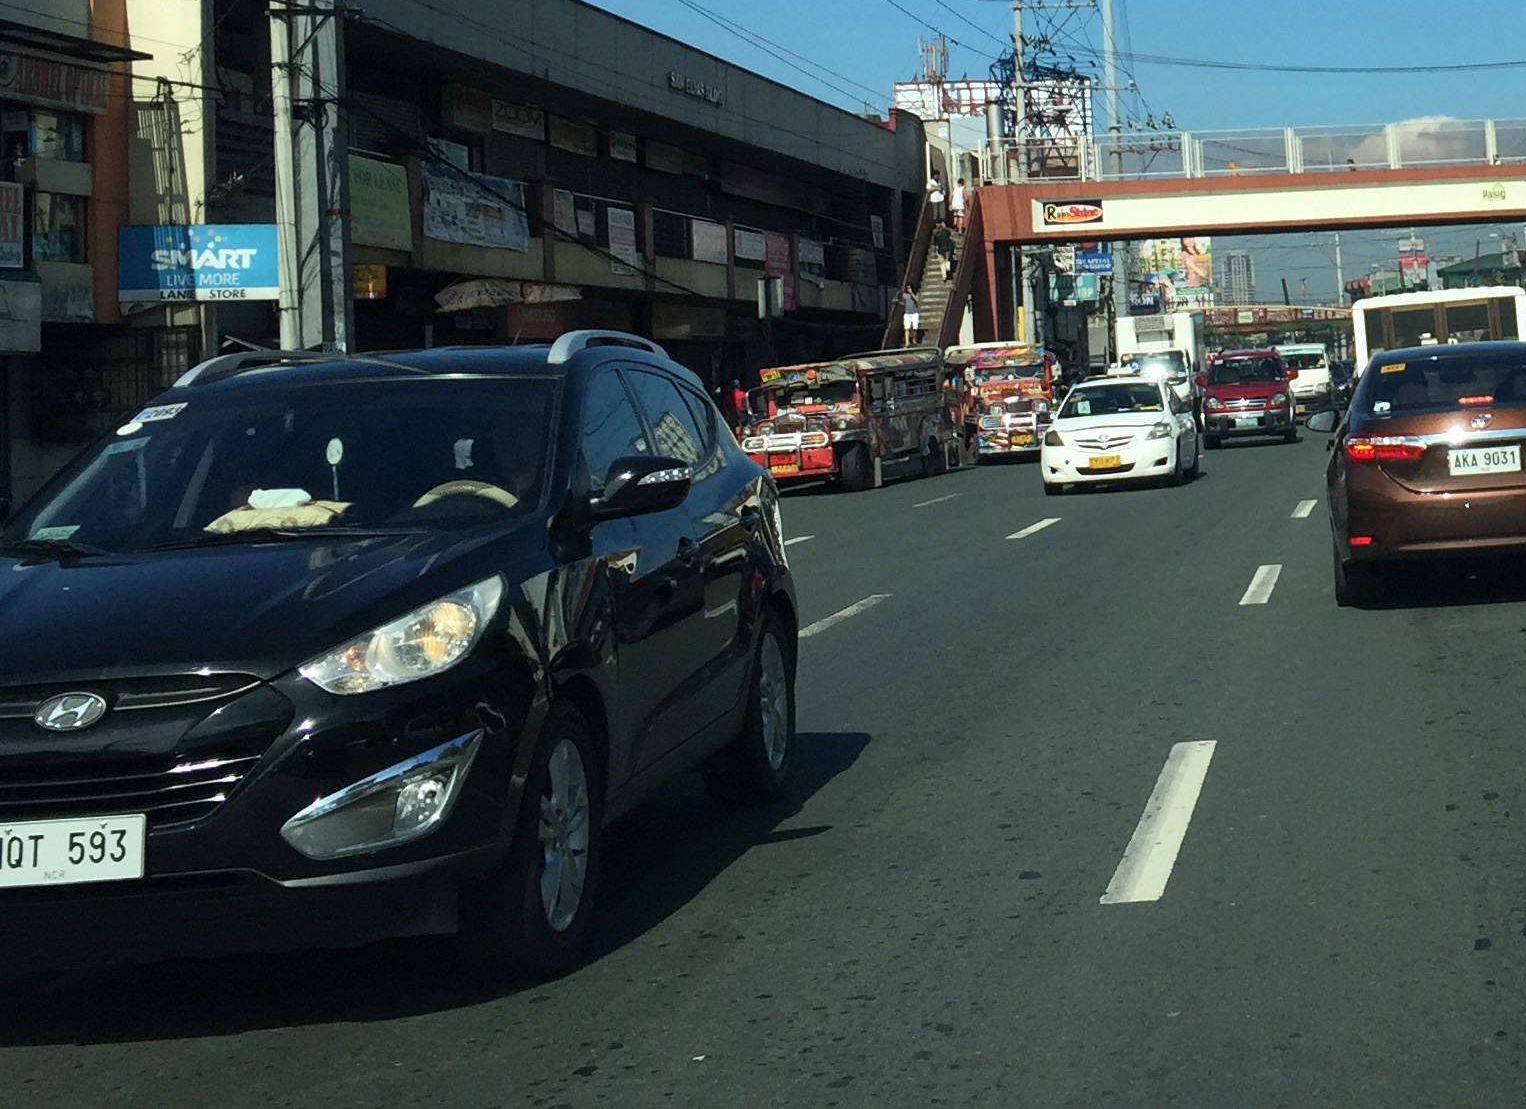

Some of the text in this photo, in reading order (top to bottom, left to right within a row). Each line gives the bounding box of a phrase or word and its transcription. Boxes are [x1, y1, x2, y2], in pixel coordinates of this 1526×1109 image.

[151, 248, 257, 270] SMART
[166, 273, 240, 287] LIVE MORE
[209, 290, 246, 299] STORE
[1454, 450, 1517, 468] AKA 9031
[0, 828, 128, 870] QT 593
